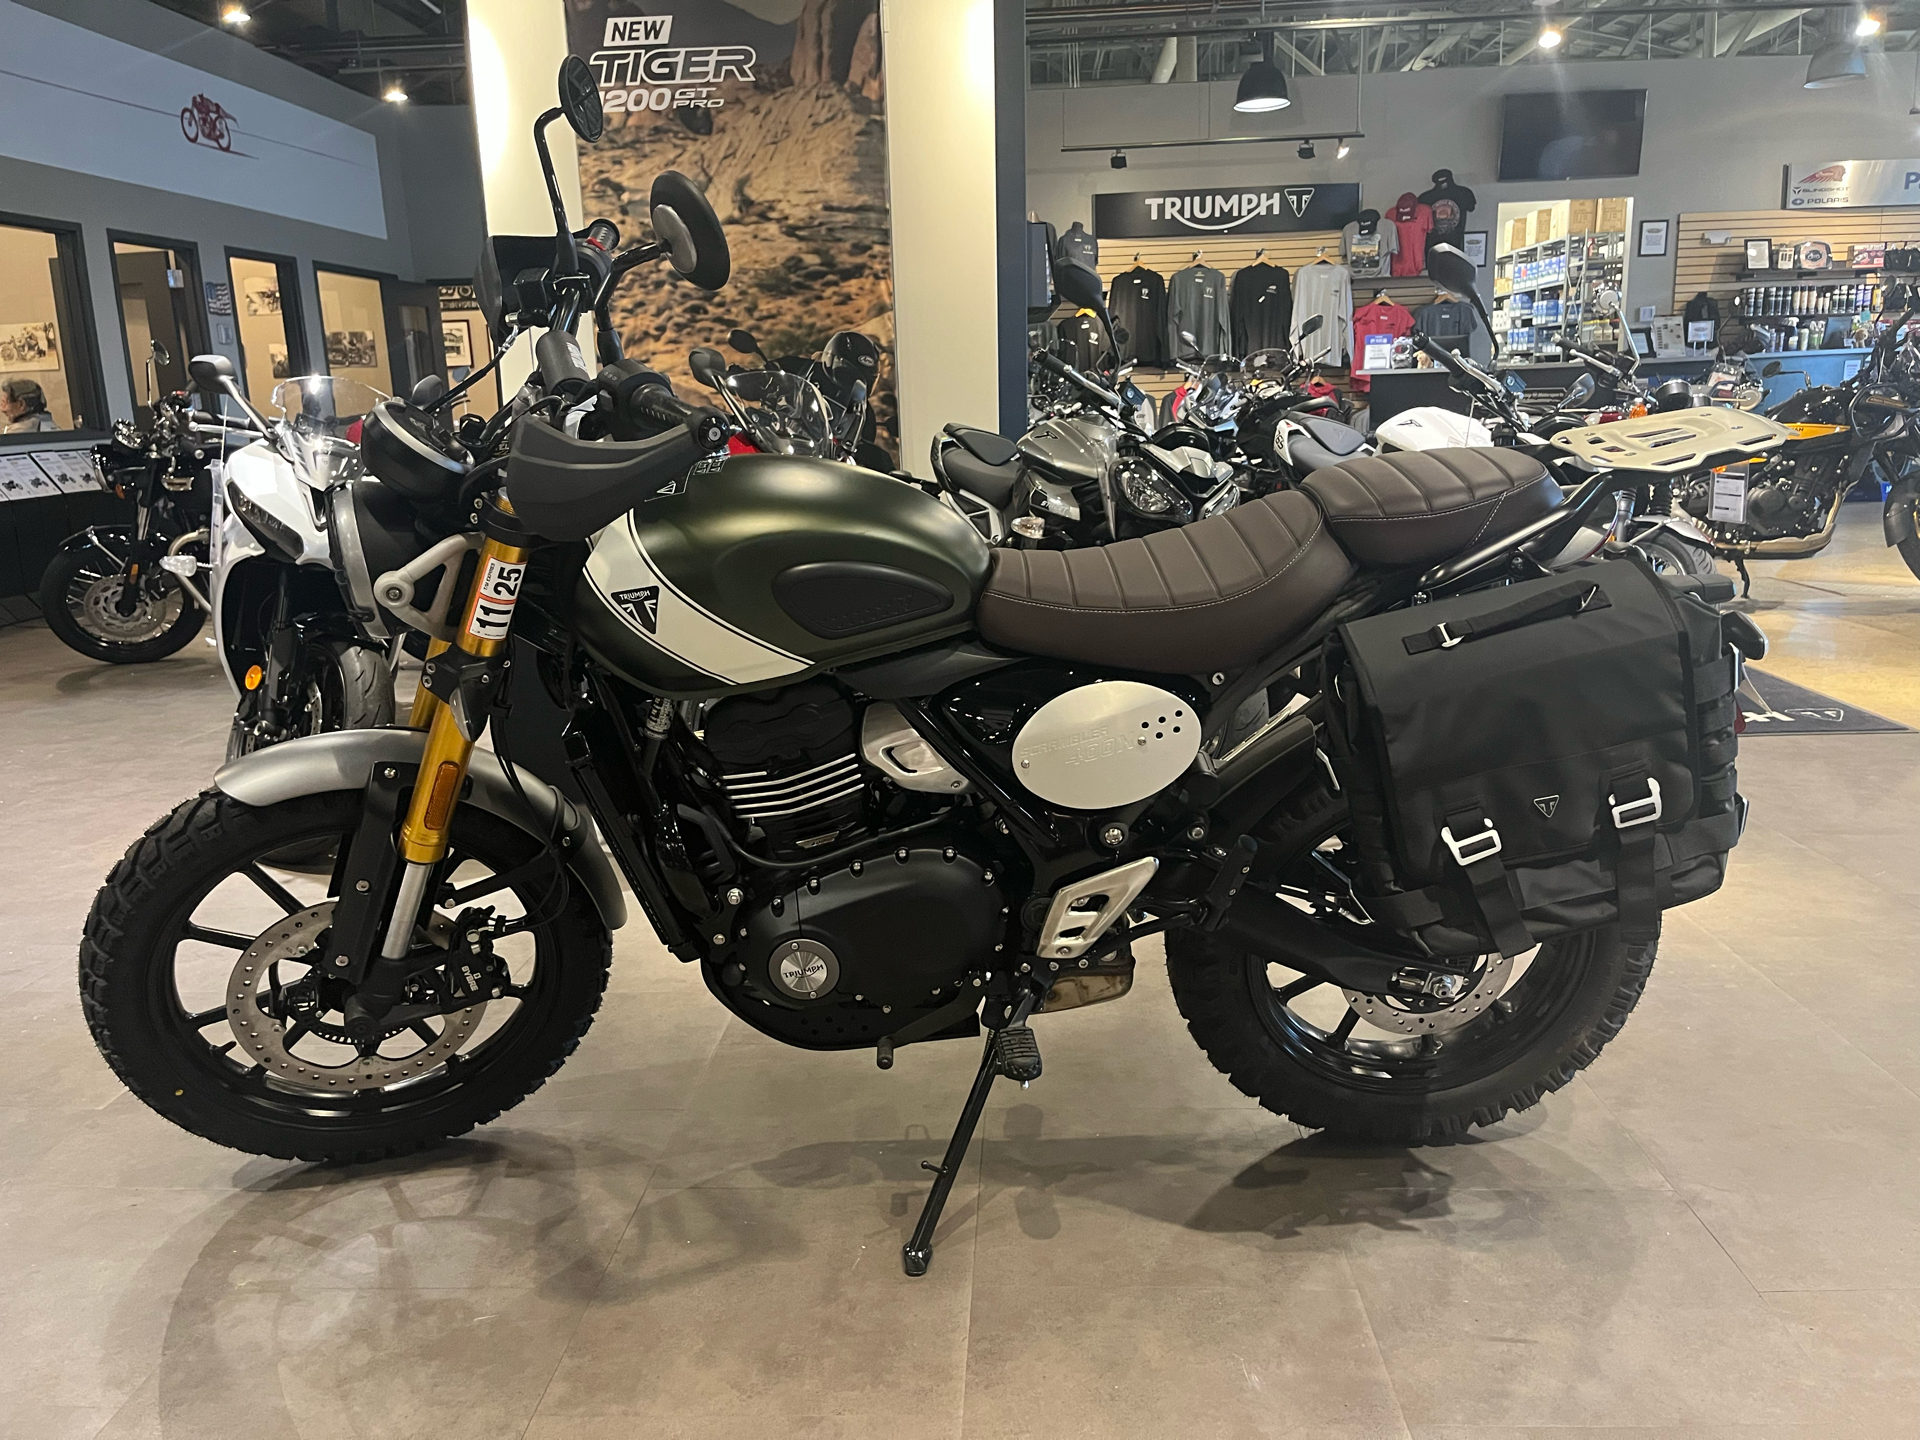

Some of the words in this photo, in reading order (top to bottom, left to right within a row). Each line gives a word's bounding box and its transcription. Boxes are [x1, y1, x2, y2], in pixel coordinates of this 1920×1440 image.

[611, 20, 665, 42] NEW
[589, 45, 757, 87] TIGER
[672, 98, 725, 109] PRO
[674, 87, 717, 99] GT
[1145, 192, 1280, 231] TRIUMPH
[1806, 197, 1849, 205] POLARIS
[493, 566, 522, 597] 25
[619, 590, 651, 602] TRIUMPH
[475, 604, 512, 629] 11
[1020, 725, 1109, 758] SCRAMBLER
[461, 965, 479, 992] BYBRE
[783, 964, 824, 979] TRIUMPH
